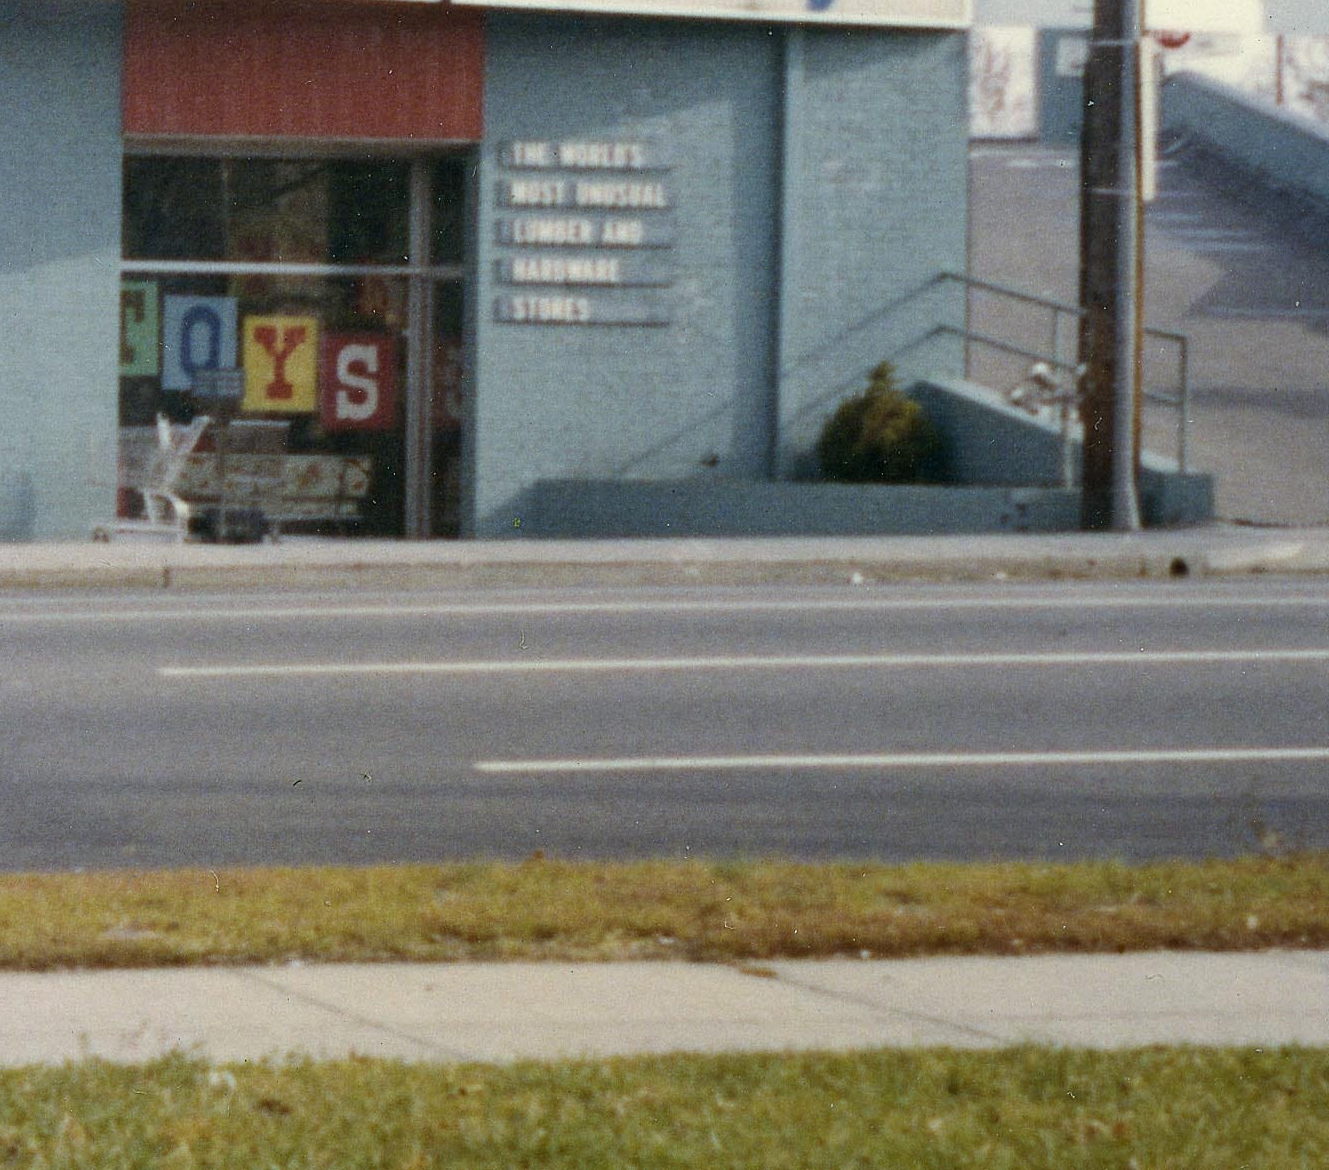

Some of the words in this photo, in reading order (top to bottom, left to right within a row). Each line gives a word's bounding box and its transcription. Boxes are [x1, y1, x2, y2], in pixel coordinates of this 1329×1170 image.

[513, 218, 593, 243] LUMBER
[601, 220, 643, 244] AND
[512, 257, 619, 282] HARDWARE
[511, 295, 590, 321] STORES
